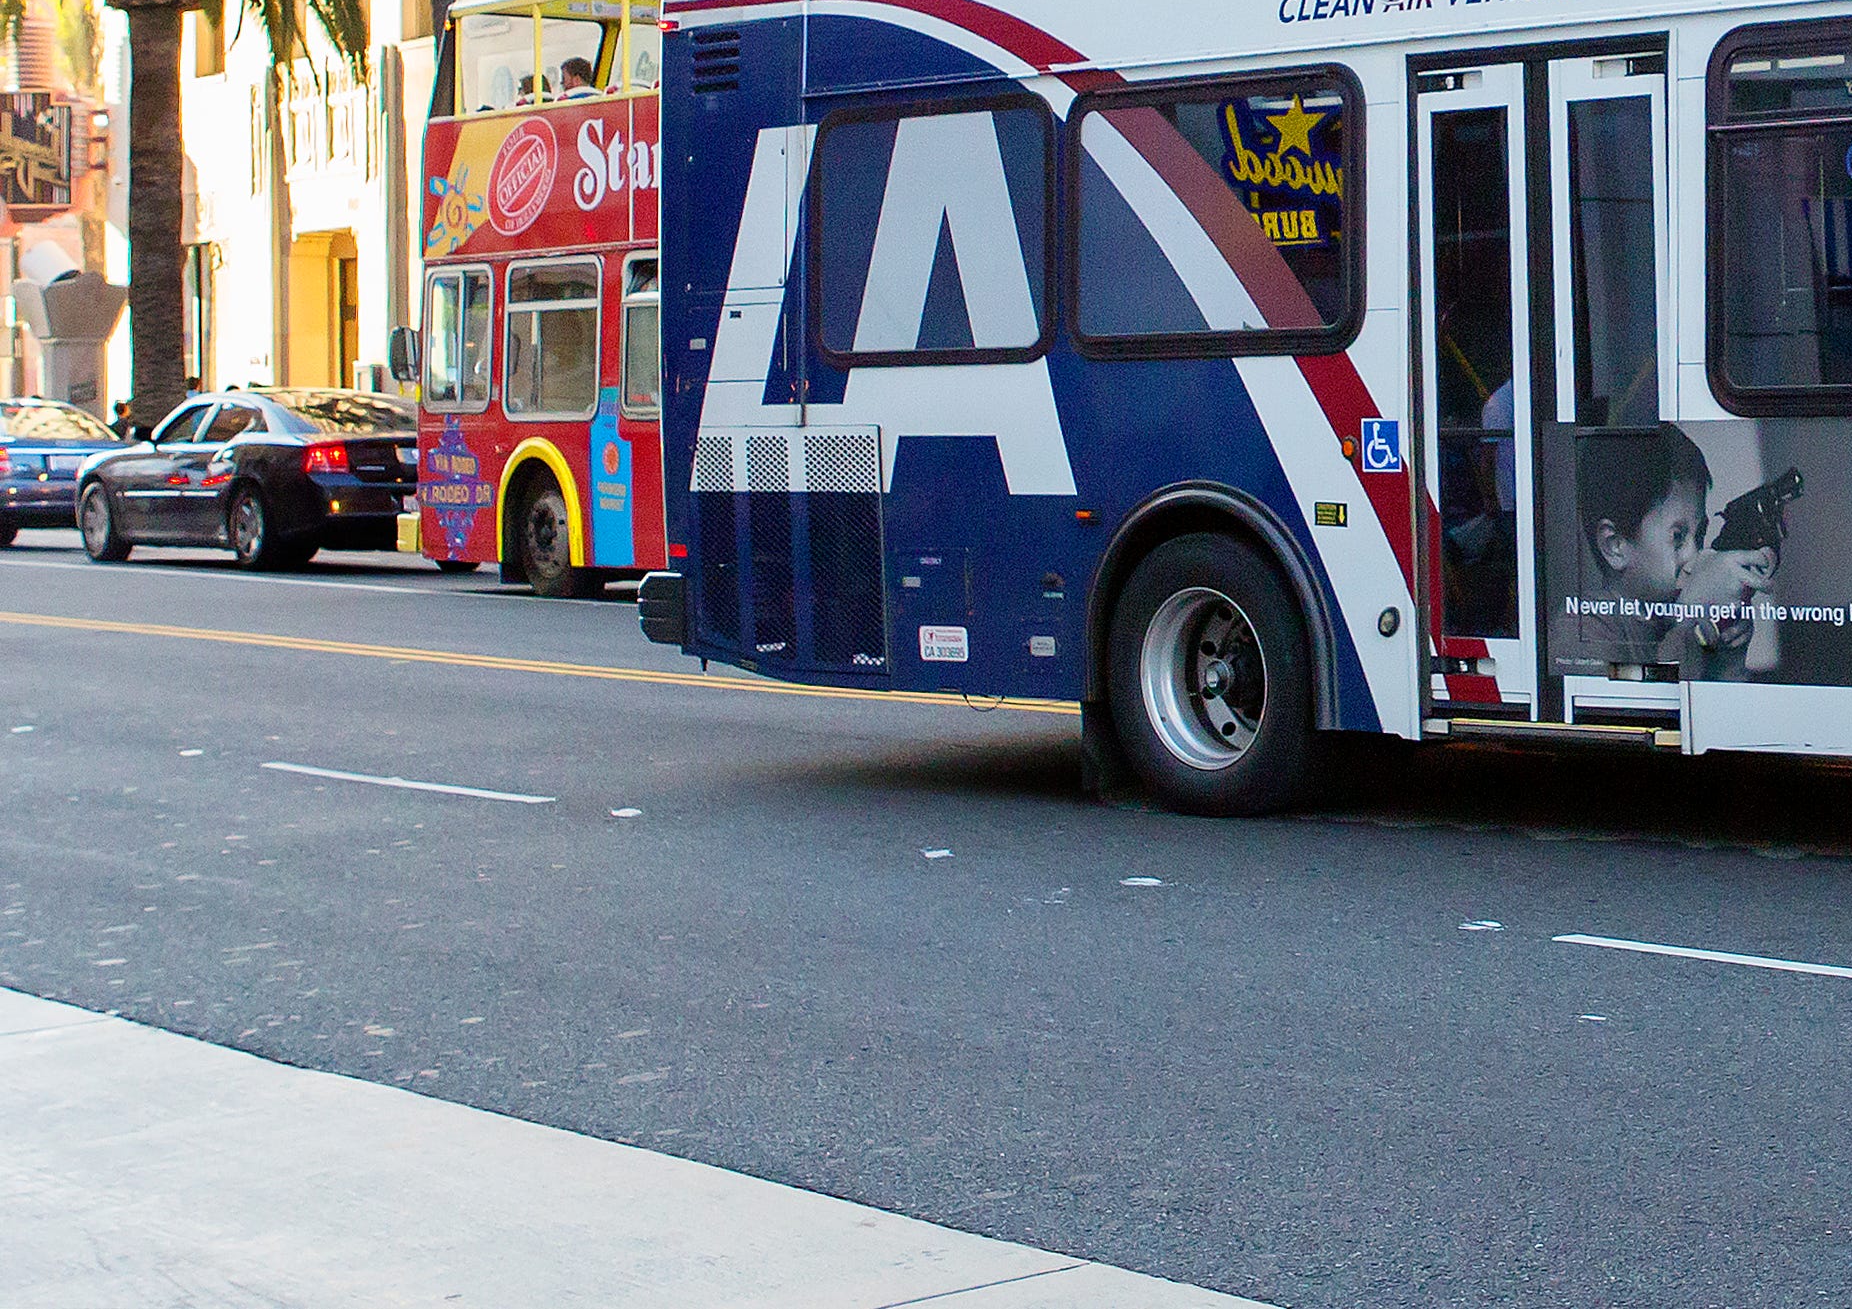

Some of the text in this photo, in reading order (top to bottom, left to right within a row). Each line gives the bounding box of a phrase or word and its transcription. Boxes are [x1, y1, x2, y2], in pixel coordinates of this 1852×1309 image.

[689, 109, 1078, 495] LA
[431, 484, 470, 504] RODEO
[1565, 596, 1616, 616] Never
[1619, 597, 1641, 616] let
[1709, 603, 1737, 622] get
[1741, 602, 1755, 620] in
[1760, 602, 1787, 621] the
[1790, 605, 1844, 627] wrong
